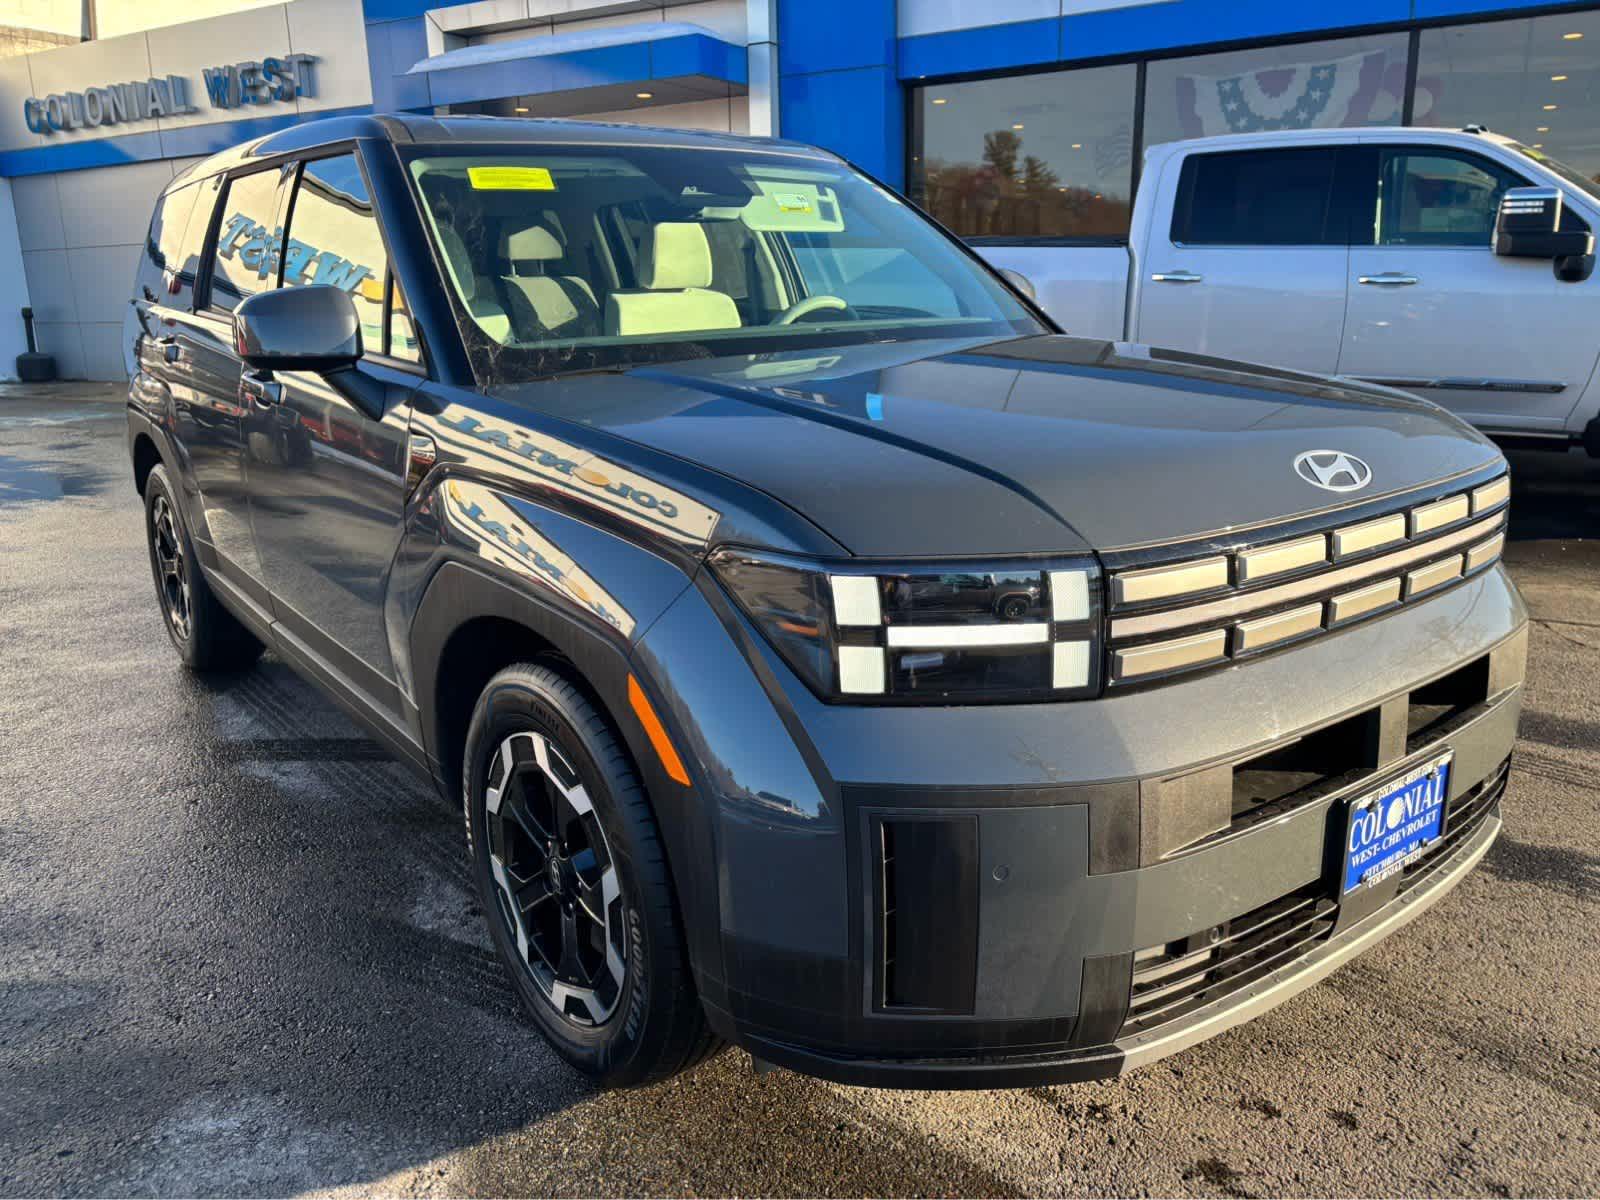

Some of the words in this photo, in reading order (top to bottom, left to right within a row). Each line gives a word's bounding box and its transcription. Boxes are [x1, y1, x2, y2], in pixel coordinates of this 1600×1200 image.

[24, 74, 197, 134] COLONIAL
[202, 53, 320, 109] WEST
[1382, 809, 1439, 851] CHEVROLET
